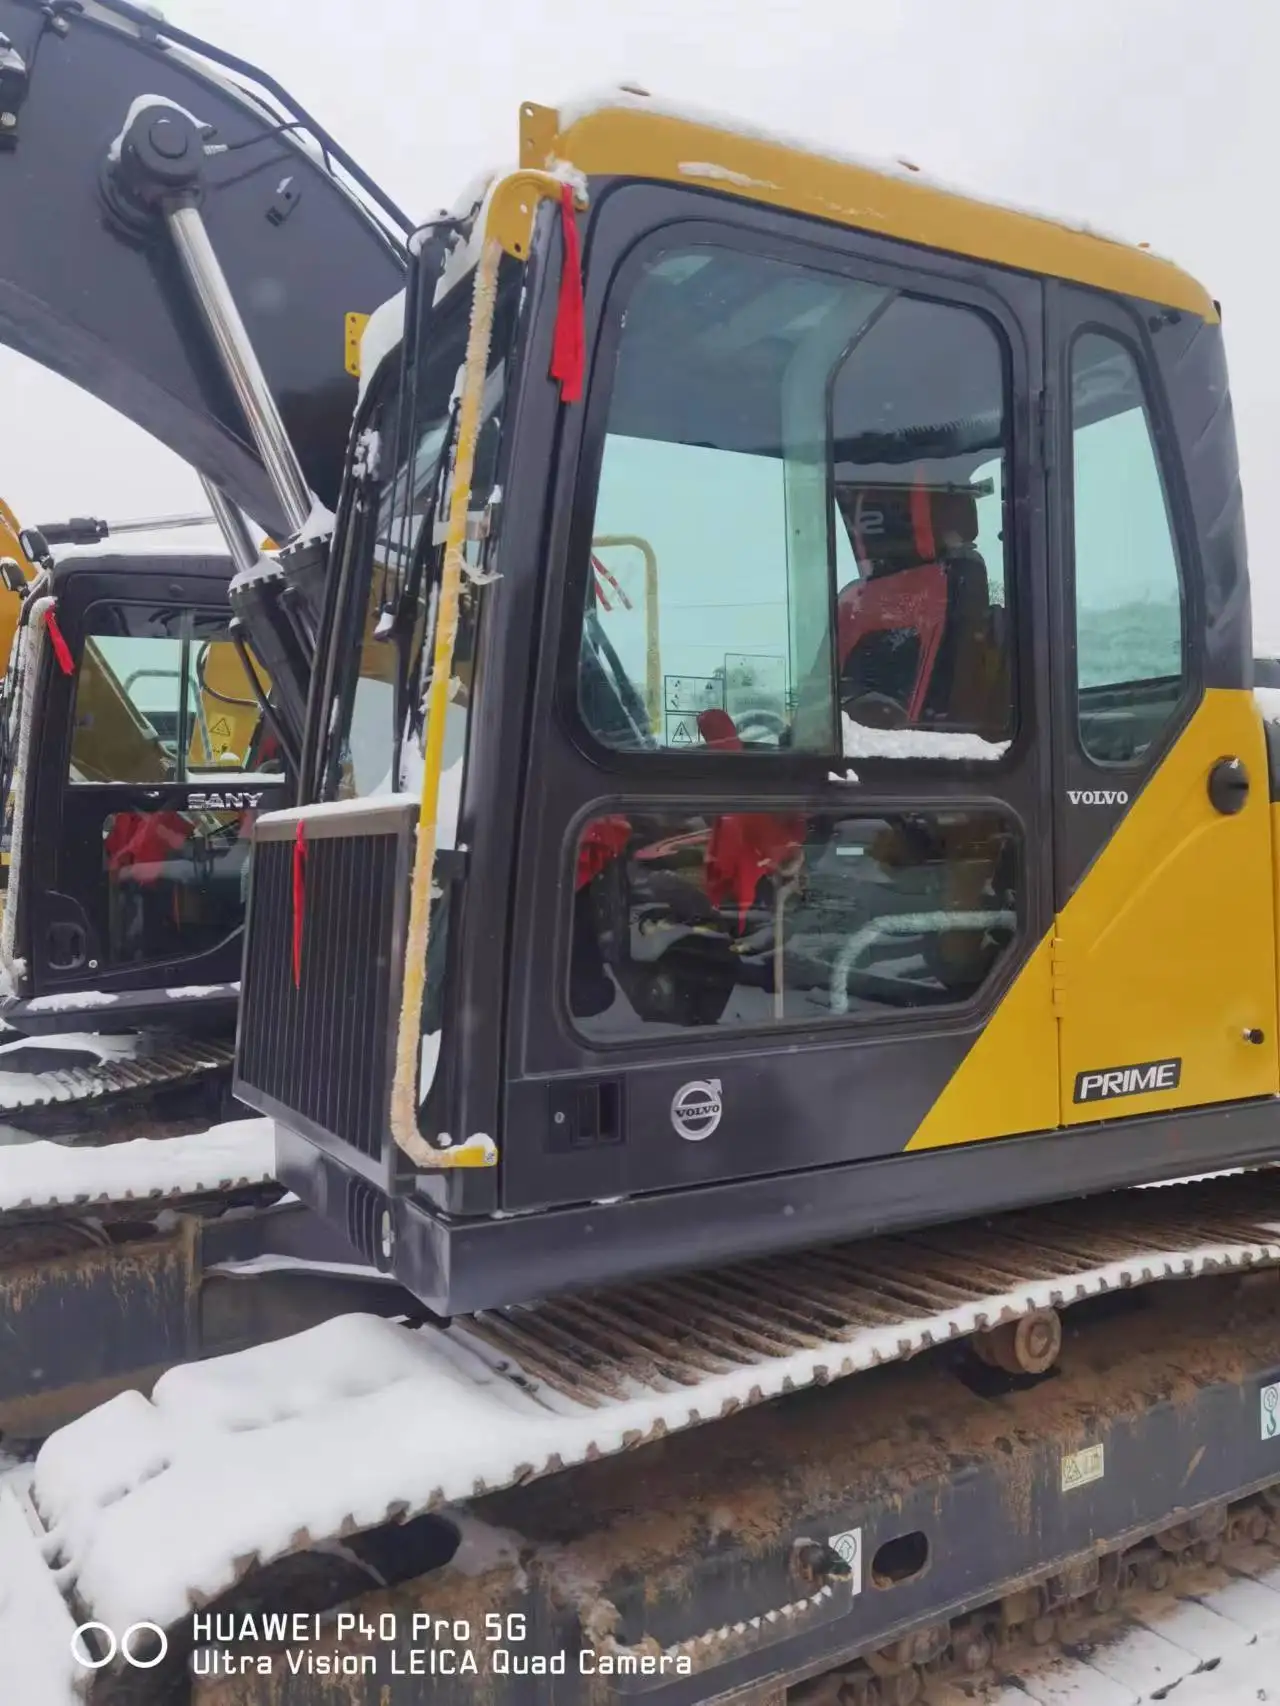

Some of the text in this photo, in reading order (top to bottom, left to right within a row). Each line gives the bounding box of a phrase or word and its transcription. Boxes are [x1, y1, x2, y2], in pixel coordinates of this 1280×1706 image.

[187, 792, 264, 809] SANY
[1066, 790, 1129, 805] VOLVO
[1080, 1063, 1177, 1100] PRIME
[675, 1104, 720, 1118] VOLVO
